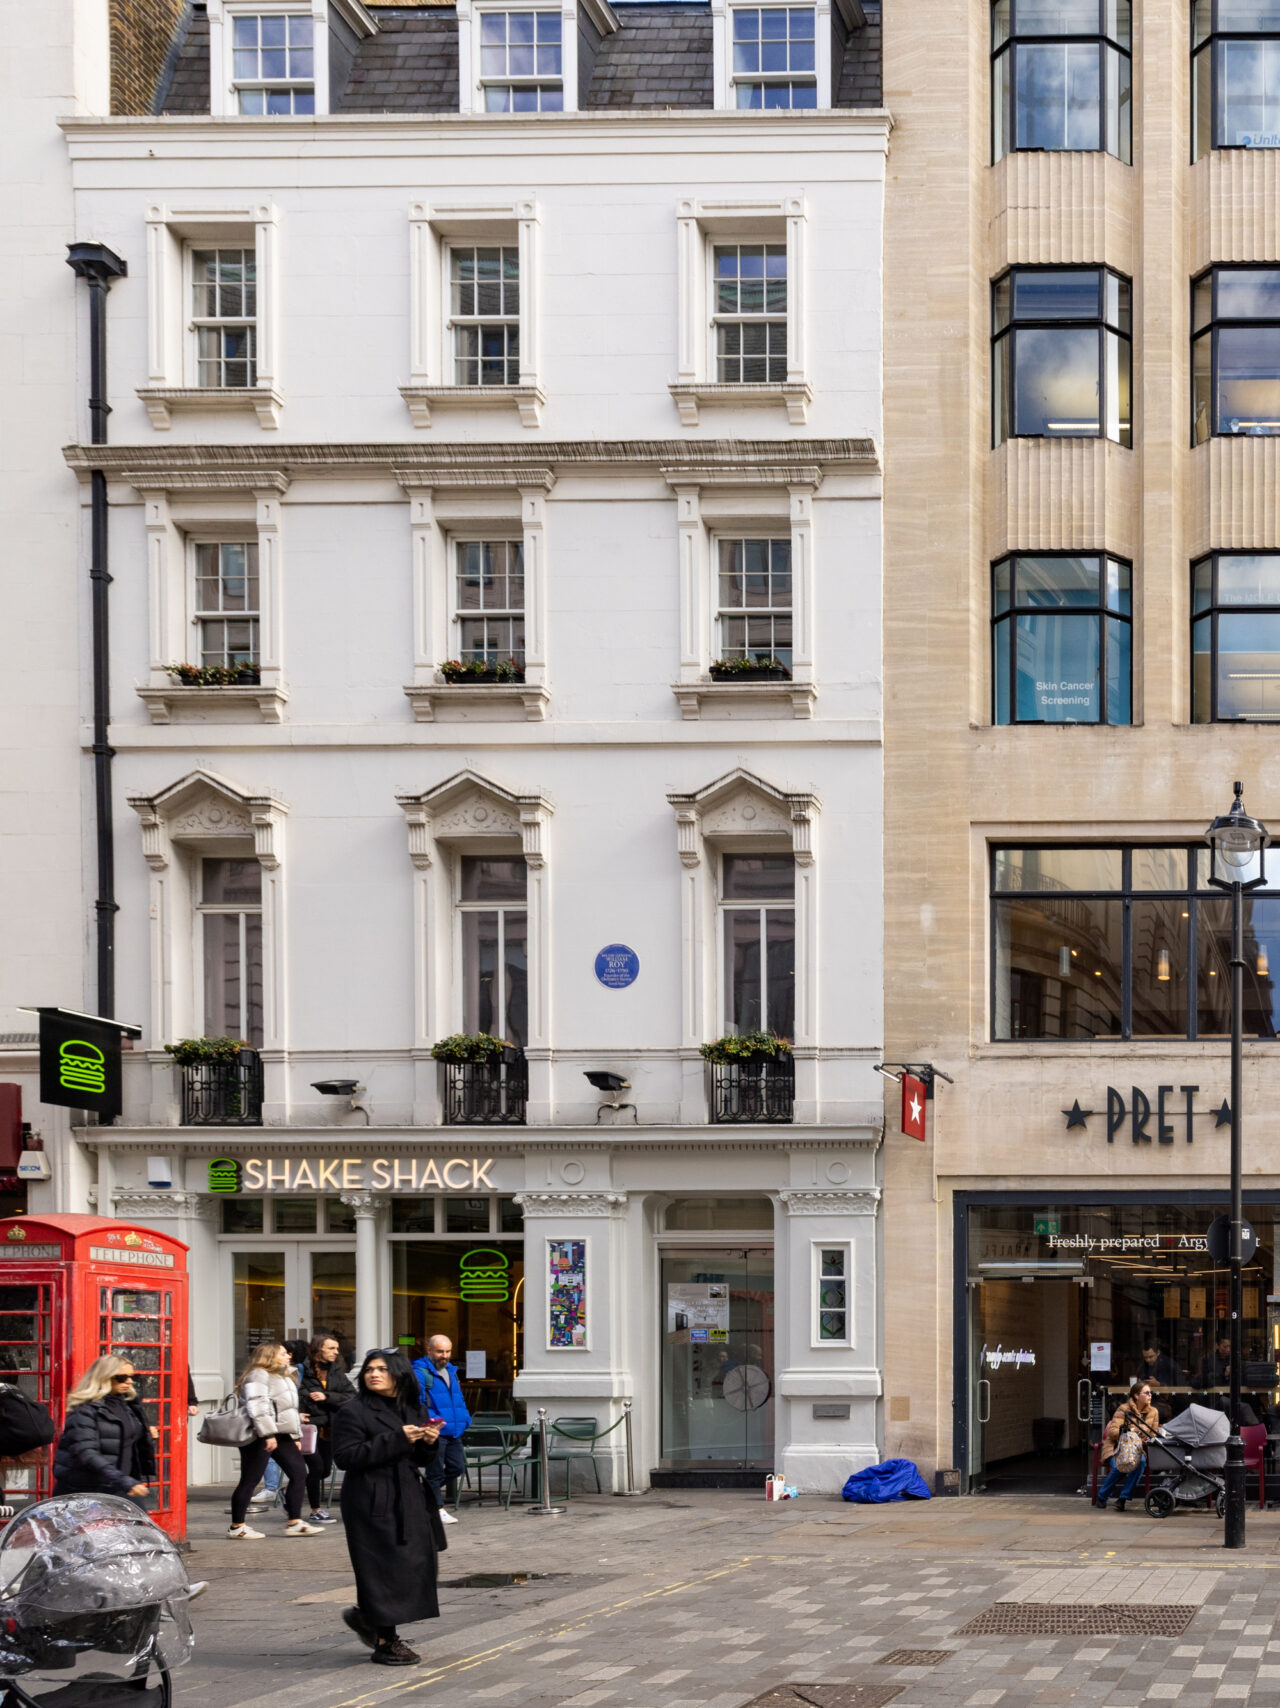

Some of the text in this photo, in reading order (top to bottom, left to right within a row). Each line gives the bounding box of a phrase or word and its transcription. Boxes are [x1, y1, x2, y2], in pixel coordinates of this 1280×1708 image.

[1036, 681, 1095, 690] Skin Cancer
[1041, 696, 1090, 706] Screening
[1107, 1086, 1200, 1143] PRET
[244, 1158, 498, 1189] SHAKE SHACK
[546, 1160, 585, 1186] 10
[810, 1159, 852, 1185] 10
[1048, 1234, 1096, 1251] Freshly
[1100, 1234, 1160, 1252] prepared
[96, 1248, 170, 1267] TELEPHONE
